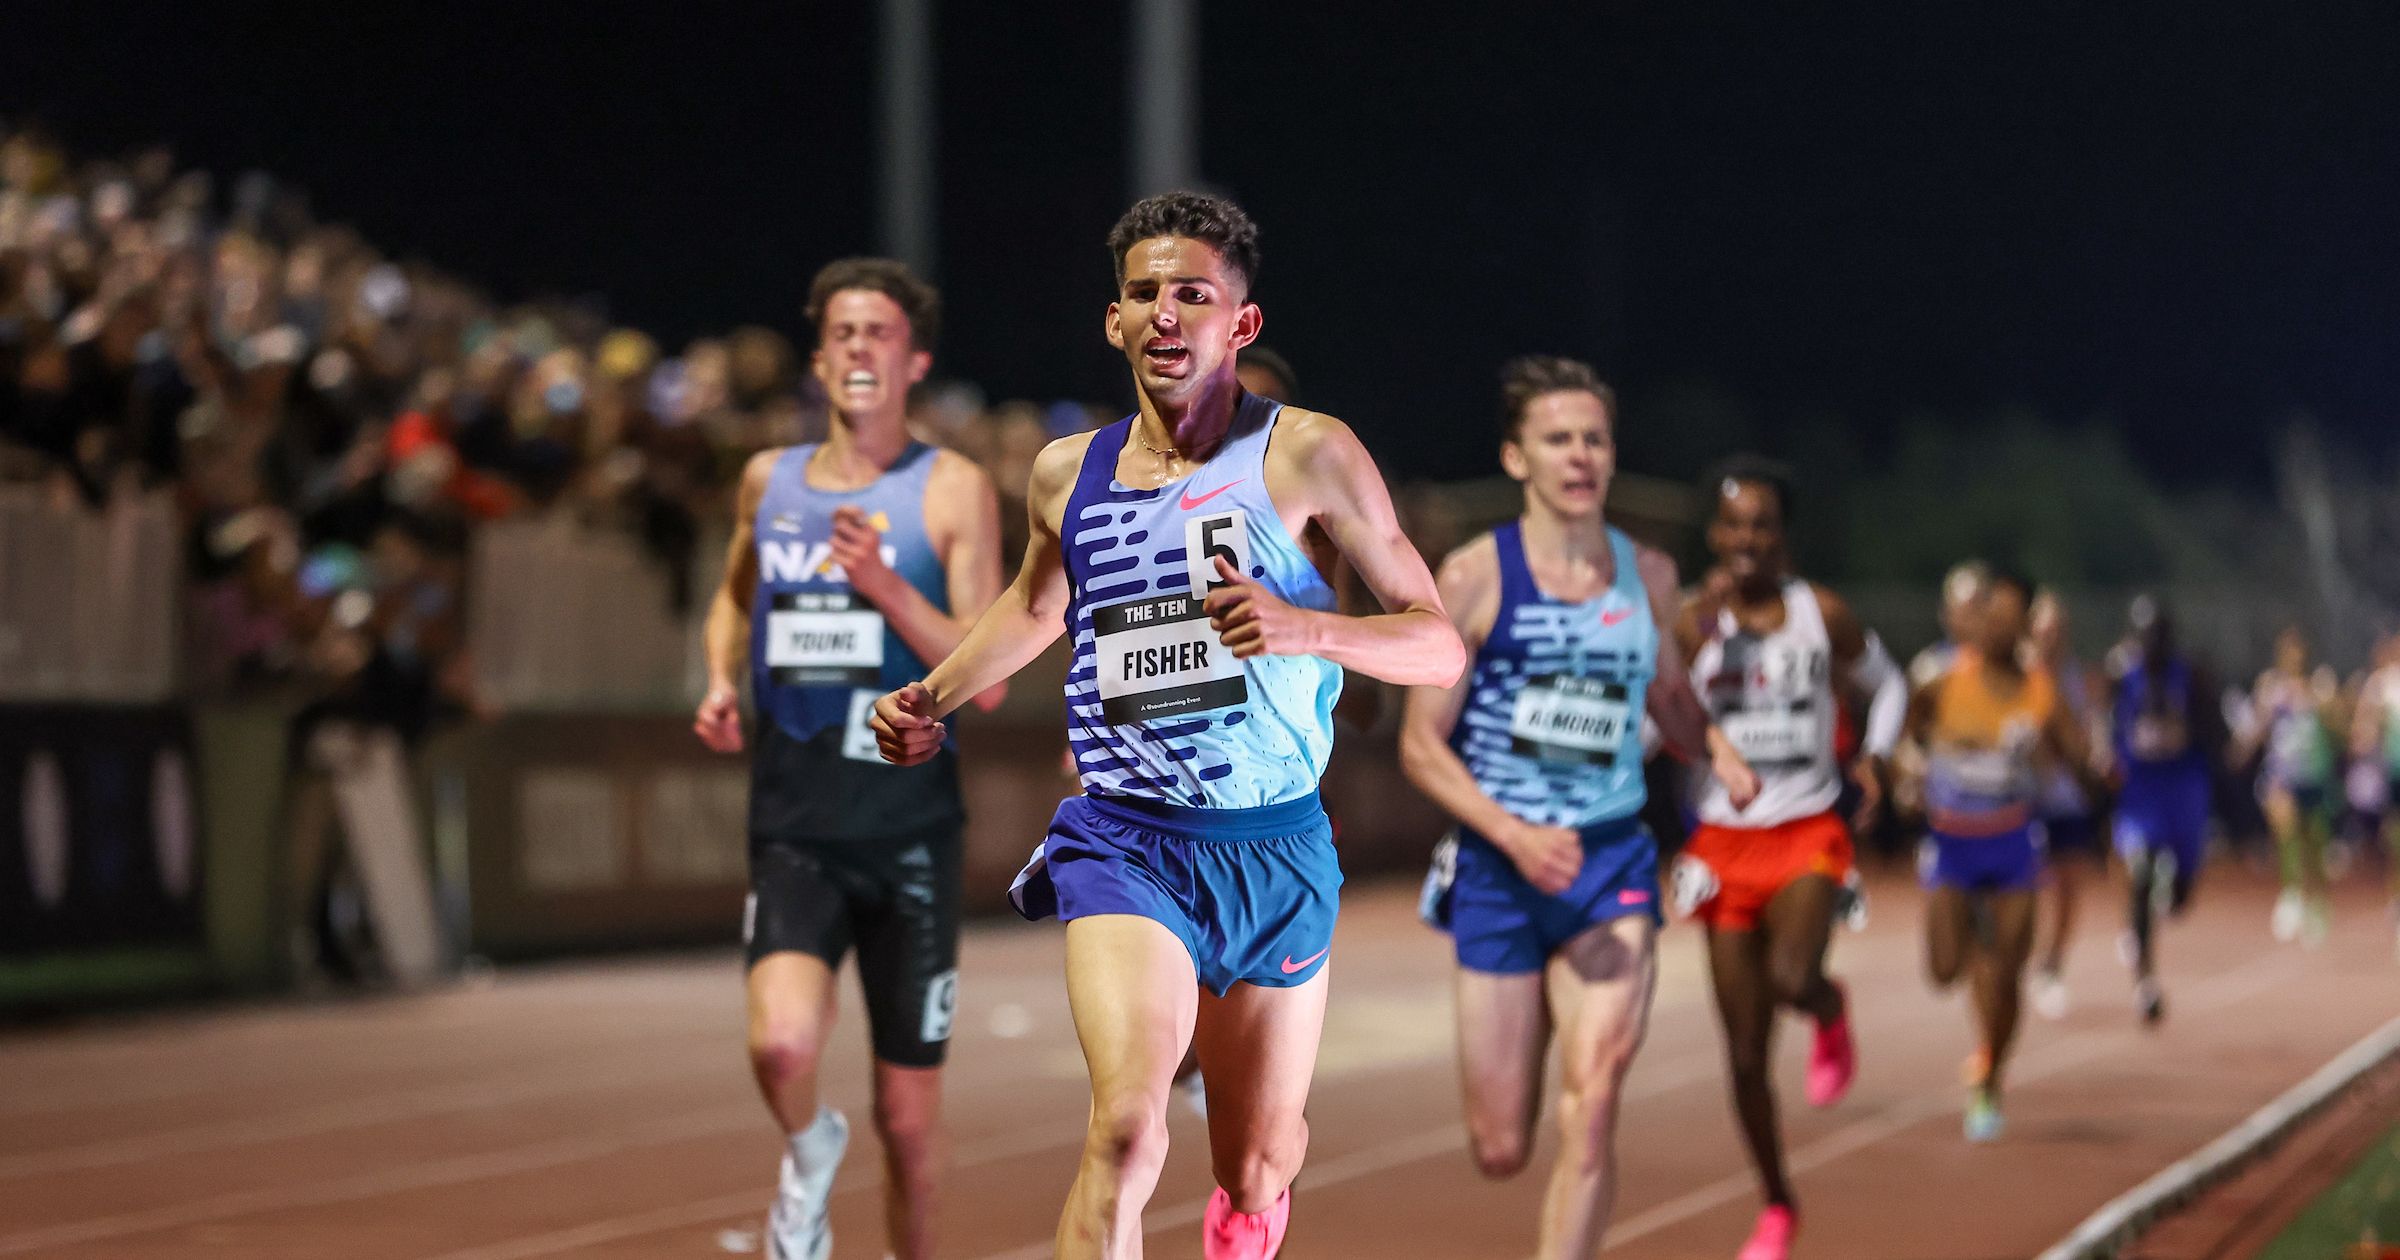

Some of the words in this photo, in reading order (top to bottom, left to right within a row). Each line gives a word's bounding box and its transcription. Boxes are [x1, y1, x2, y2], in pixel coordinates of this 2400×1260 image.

[1202, 517, 1240, 592] 5
[1125, 604, 1154, 623] THE
[1158, 599, 1187, 618] TEN
[1123, 640, 1209, 681] FISHER
